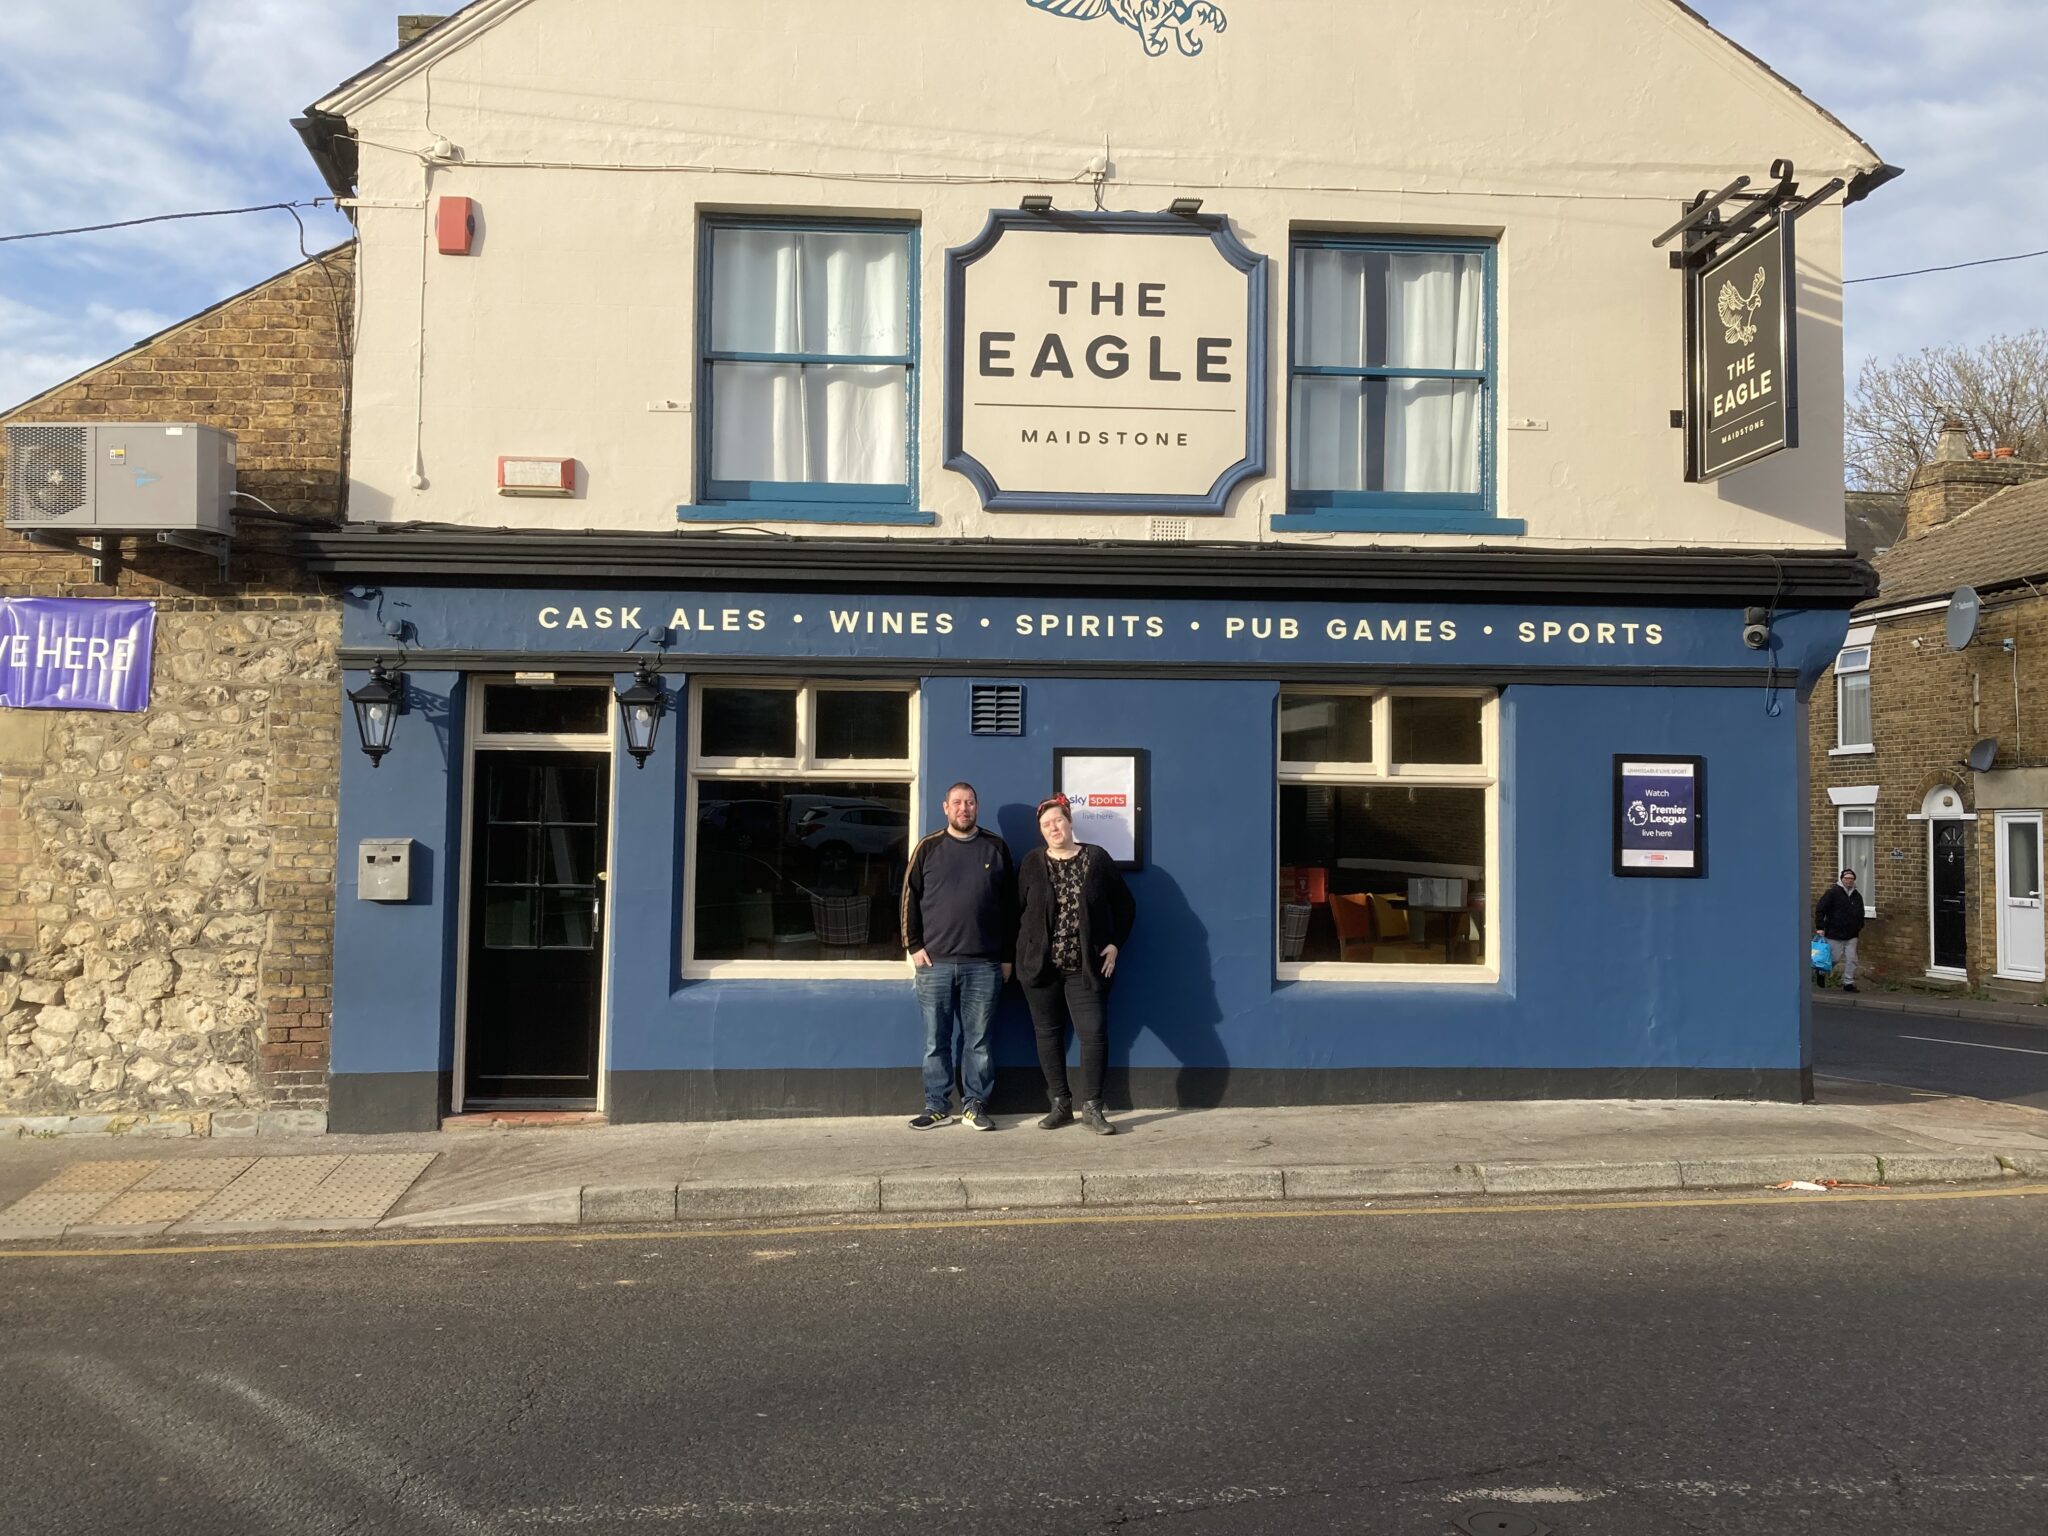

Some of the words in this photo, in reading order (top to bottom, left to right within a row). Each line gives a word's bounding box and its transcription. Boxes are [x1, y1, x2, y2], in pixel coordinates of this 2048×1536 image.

[1049, 280, 1166, 317] THE
[979, 331, 1233, 383] EAGLE
[1726, 352, 1756, 381] THE
[1713, 369, 1773, 418] EAGLE
[1021, 429, 1188, 447] MAIDSTONE
[1721, 418, 1765, 444] MAIDSTONE
[538, 606, 642, 629] CASK
[668, 607, 766, 631] ALES
[829, 610, 954, 634] WINES
[1015, 614, 1164, 637] SPIRITS
[1226, 617, 1299, 639] PUB
[1326, 618, 1457, 641] GAMES
[1518, 621, 1663, 645] SPORTS
[36, 636, 134, 671] HERE
[1069, 794, 1087, 806] sky
[1090, 796, 1125, 806] sports
[1645, 789, 1670, 797] Watch
[1650, 804, 1687, 814] Premier
[1650, 814, 1687, 825] League
[1642, 829, 1655, 837] live
[1655, 829, 1672, 837] here
